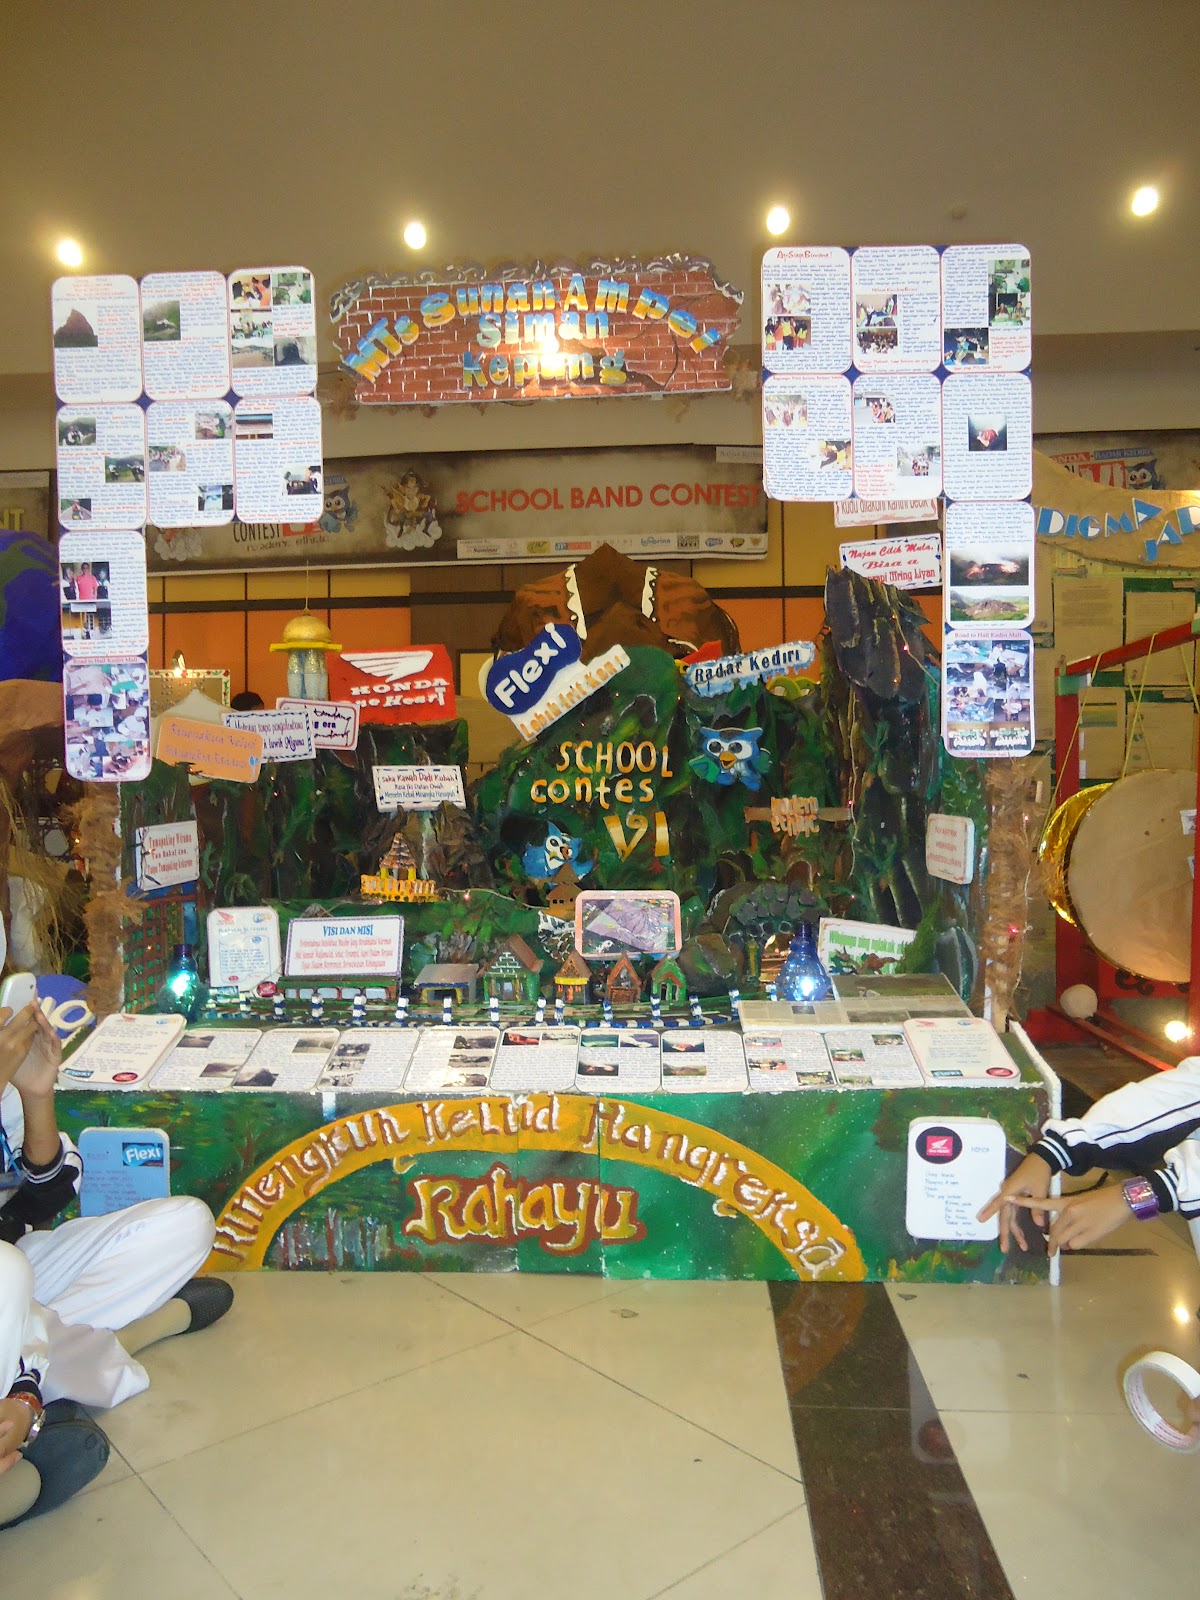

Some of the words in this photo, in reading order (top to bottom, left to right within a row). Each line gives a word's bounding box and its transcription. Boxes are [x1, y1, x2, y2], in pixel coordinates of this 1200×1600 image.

[343, 315, 420, 384] MTs
[420, 280, 557, 328] Sunan
[477, 309, 609, 349] Siman
[456, 488, 564, 514] SCHOOL
[570, 485, 643, 510] BAND
[650, 482, 761, 507] CONTEST
[233, 522, 281, 543] CONTEST
[494, 622, 567, 708] Flexi
[695, 662, 743, 682] Radar
[749, 649, 800, 672] Kediri
[350, 678, 450, 696] HONDA
[556, 740, 674, 778] SCHOOL
[323, 925, 338, 937] VISI
[340, 926, 355, 936] DAN
[357, 925, 373, 936] MISI
[126, 1141, 161, 1163] Flexi
[405, 1165, 639, 1251] Rahayu
